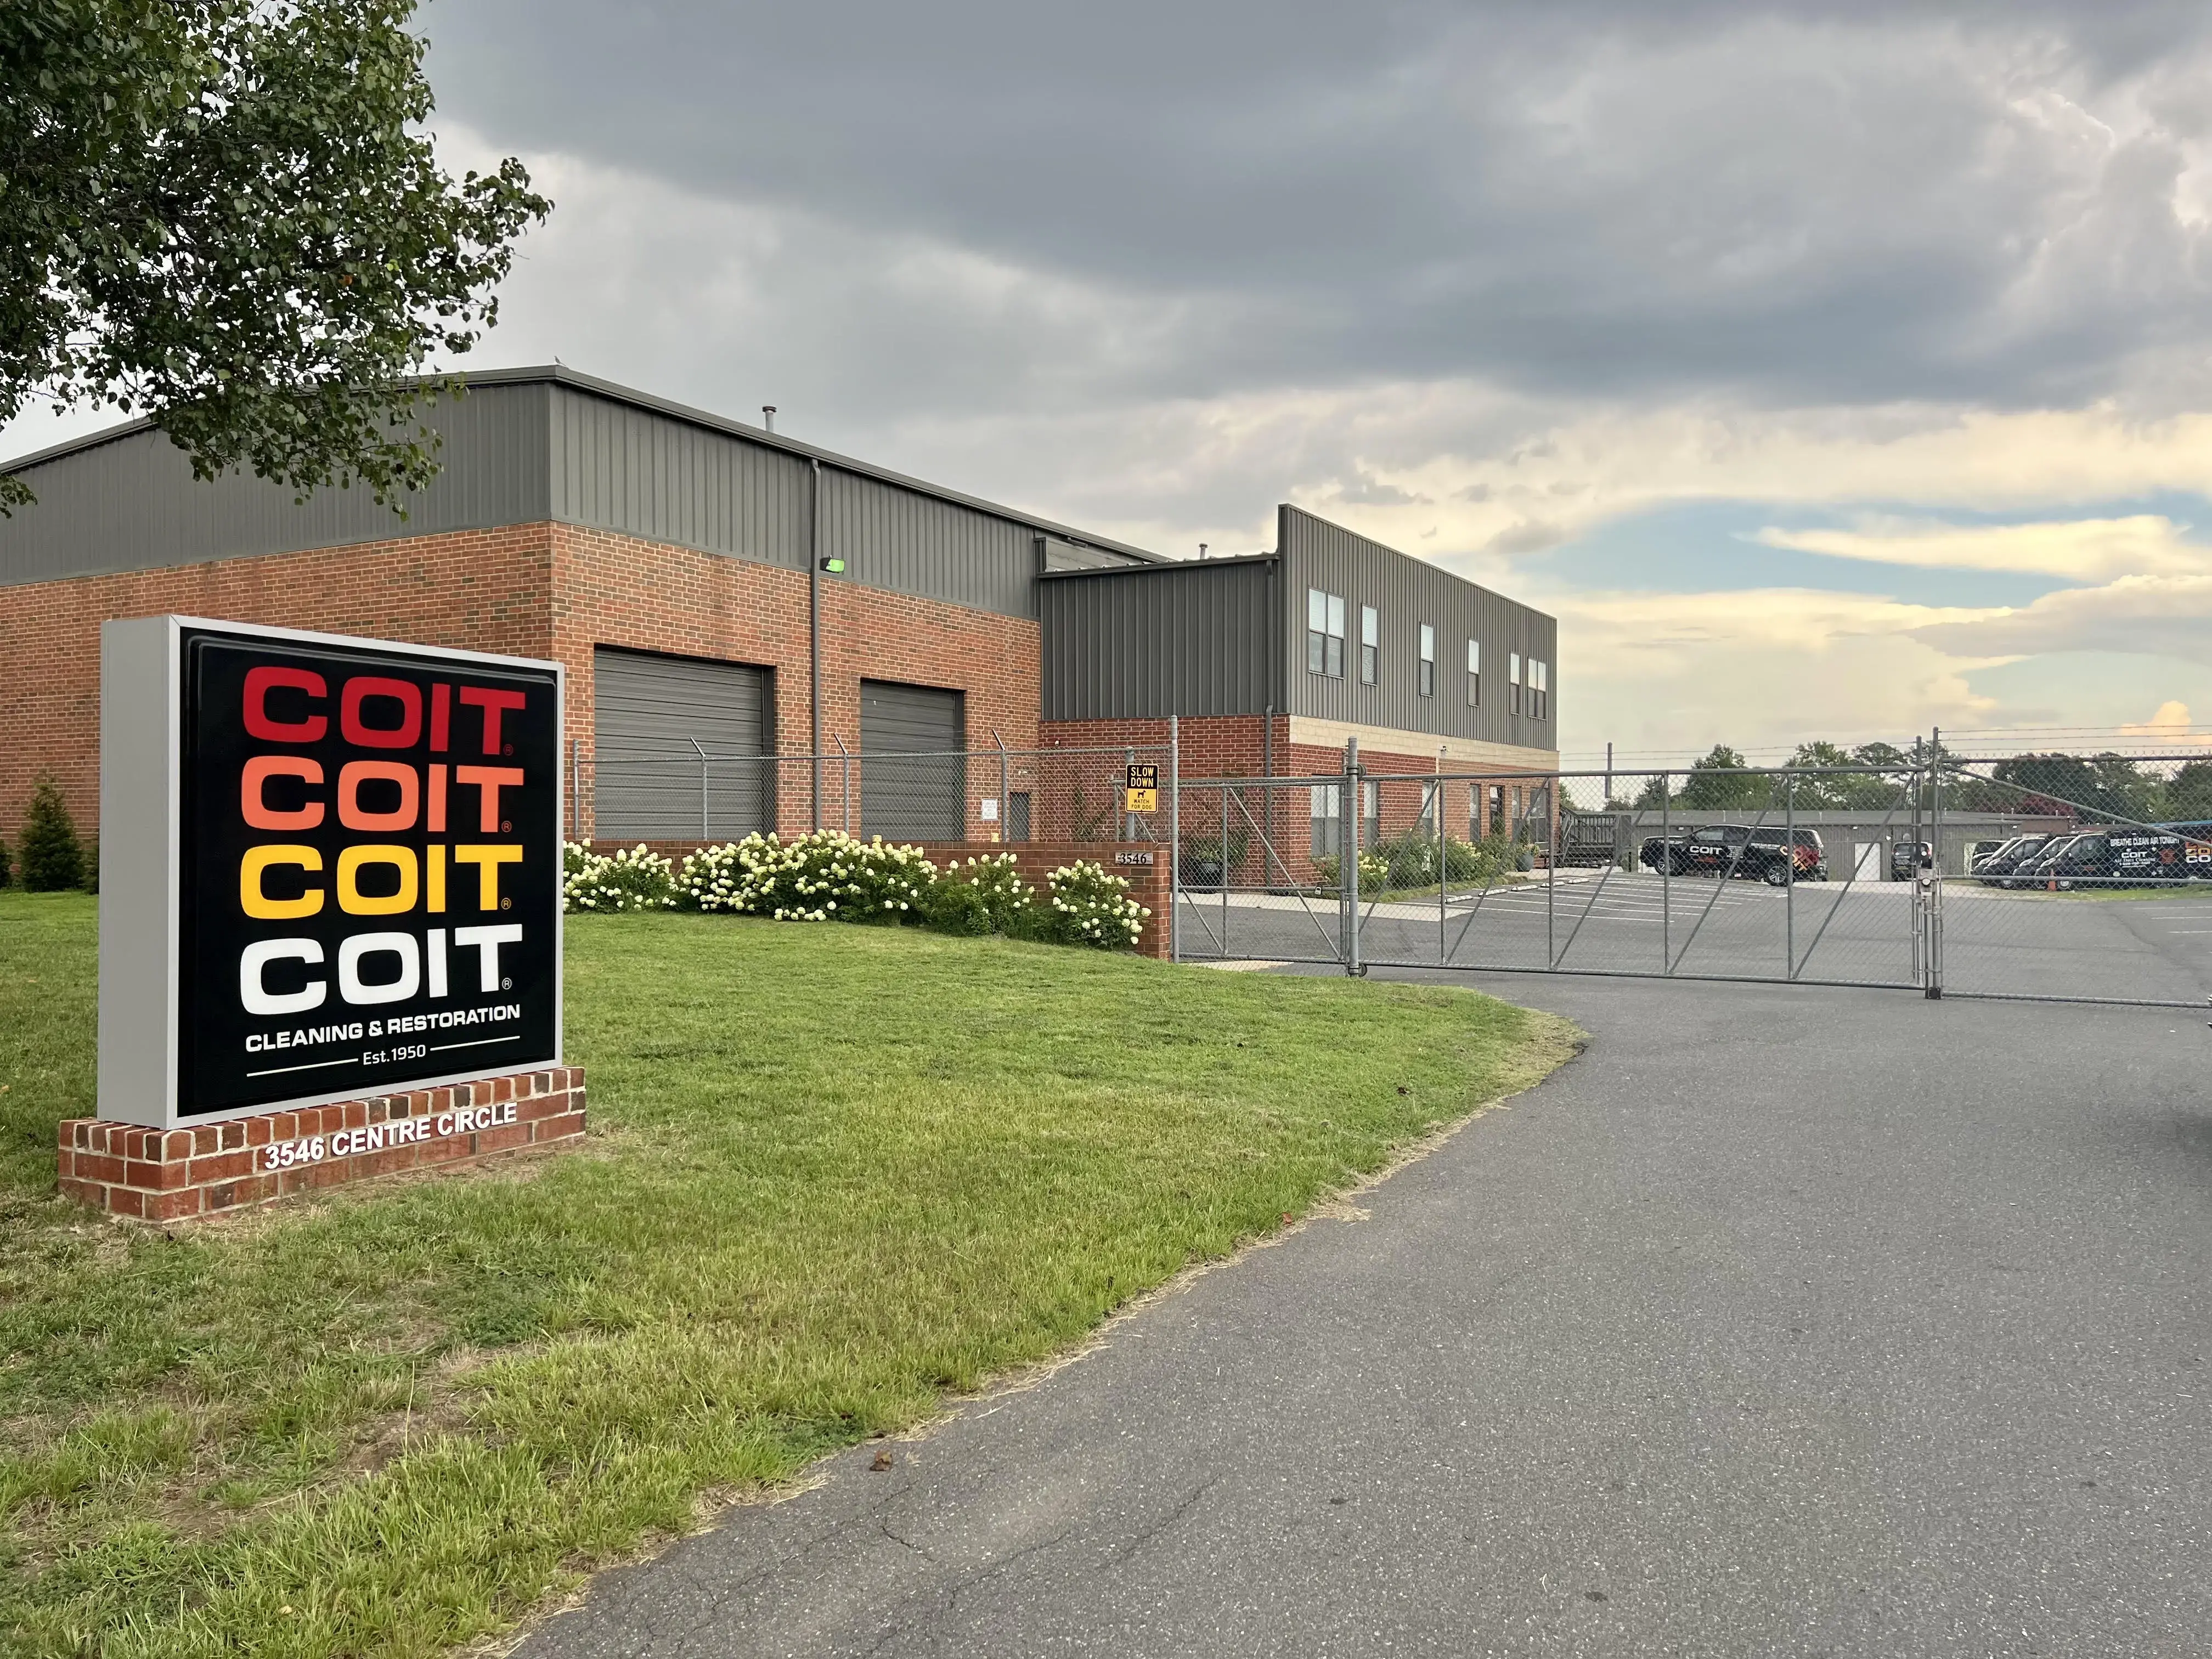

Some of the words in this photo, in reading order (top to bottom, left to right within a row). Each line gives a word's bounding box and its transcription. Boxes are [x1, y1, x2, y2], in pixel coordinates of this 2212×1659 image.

[1131, 767, 1154, 777] SLOW
[1131, 777, 1154, 787] DOWN
[2110, 838, 2132, 847] BREATHE
[2132, 837, 2149, 846] CLEAN
[1690, 845, 1723, 855] COIT
[1118, 853, 1147, 865] 3546
[245, 1023, 363, 1052] CLEANING
[368, 1020, 383, 1037] &
[387, 1004, 521, 1035] RESTORATION
[264, 1137, 325, 1171] 3546
[331, 1117, 431, 1156] CENTRE
[437, 1102, 518, 1137] CIRCLE
